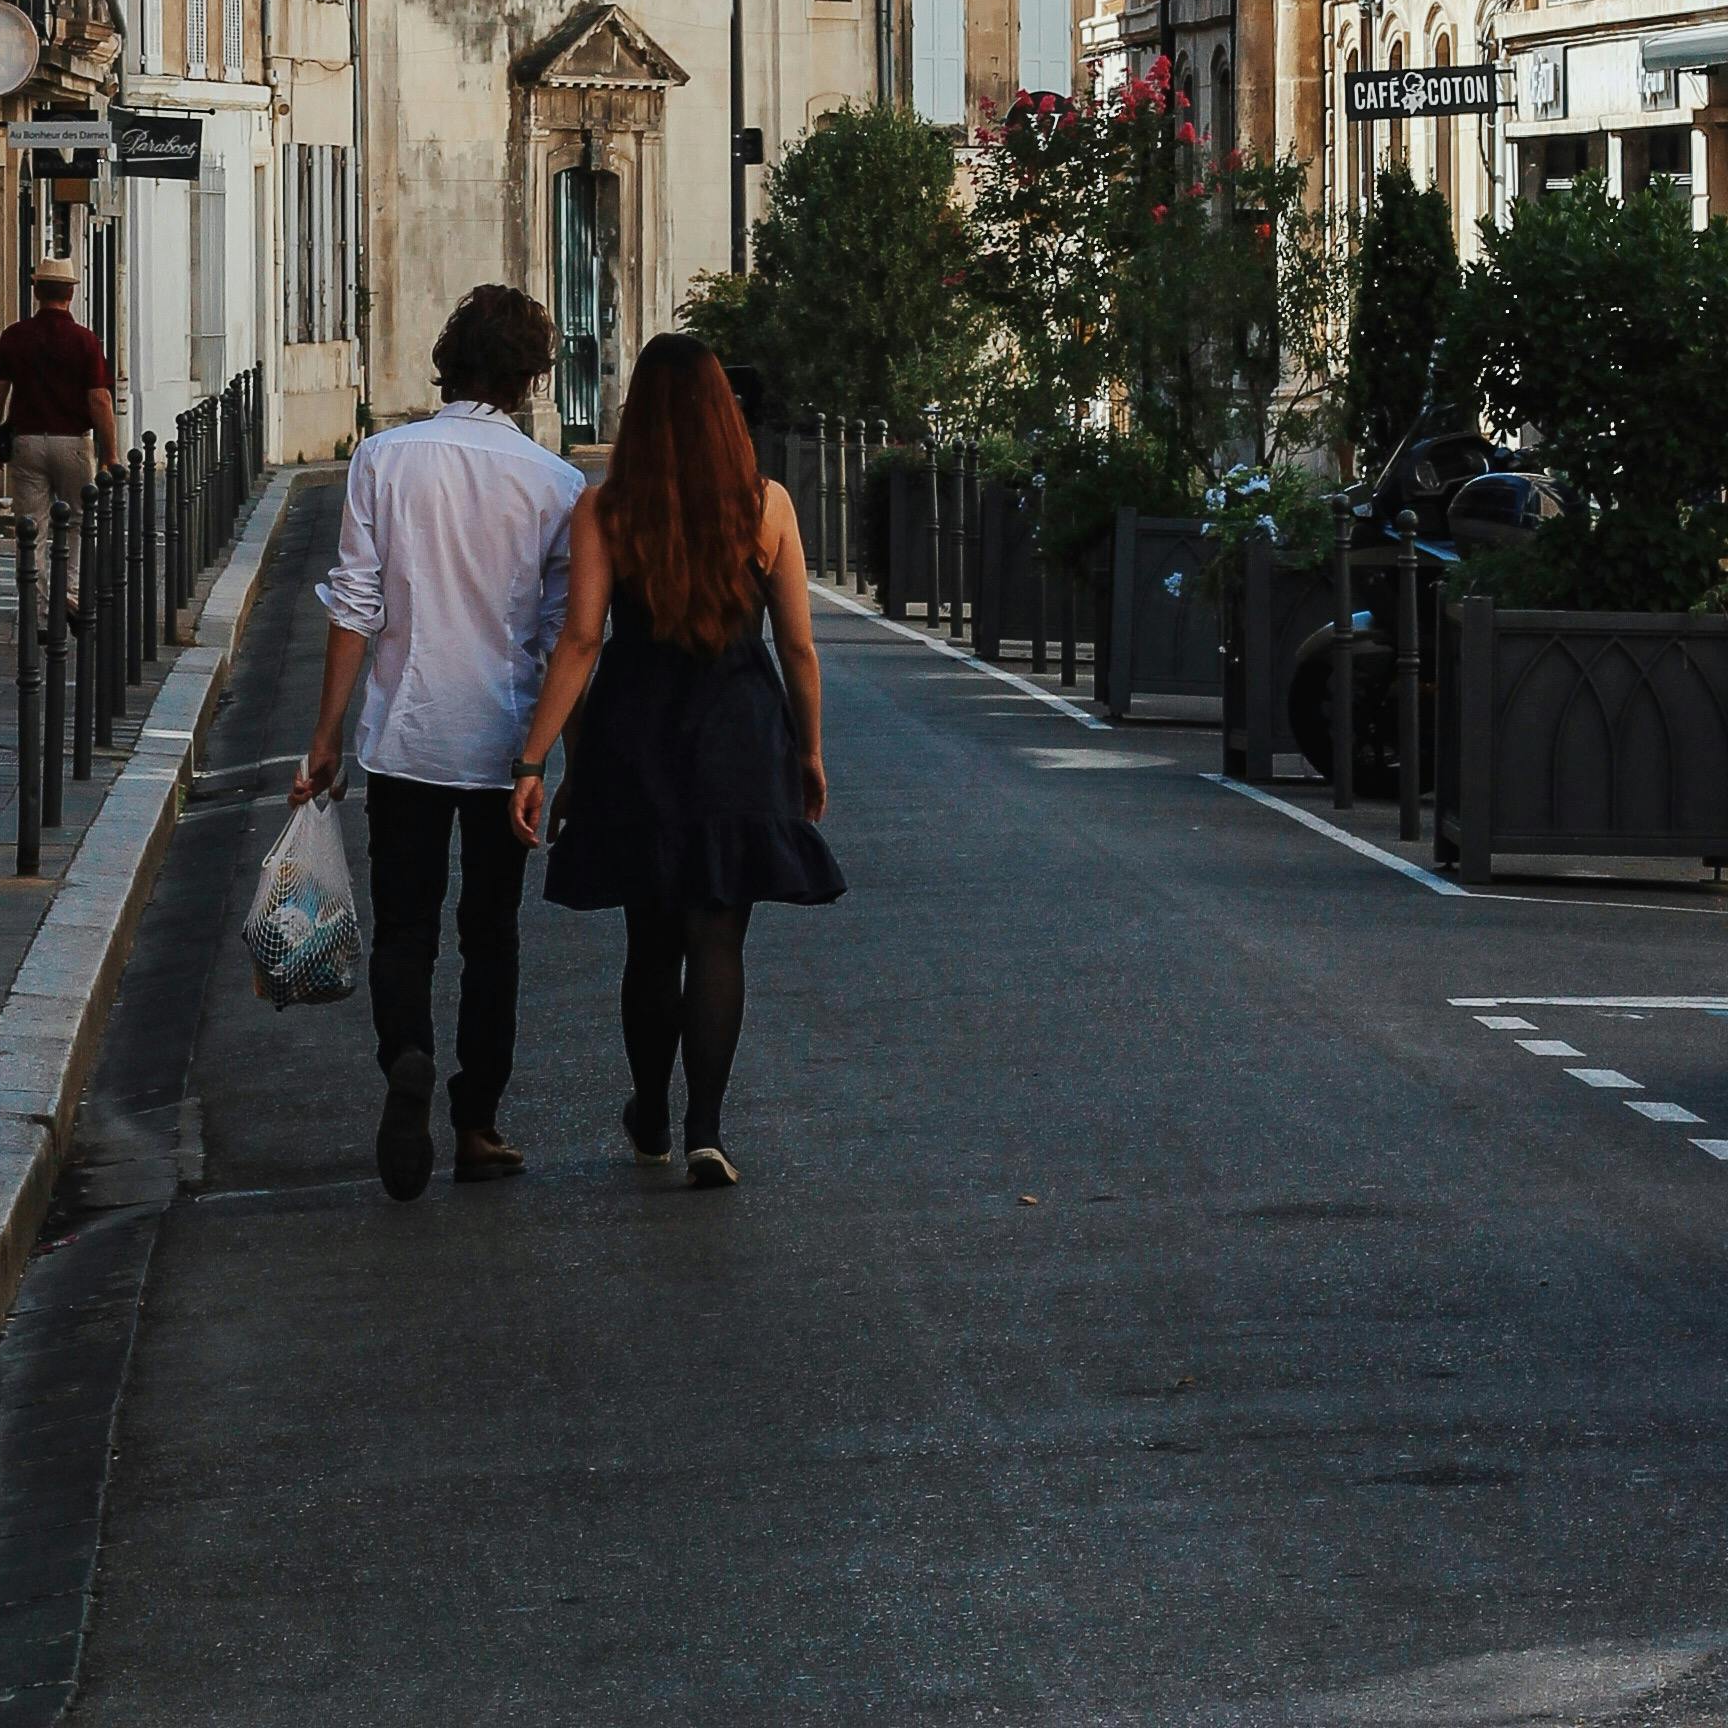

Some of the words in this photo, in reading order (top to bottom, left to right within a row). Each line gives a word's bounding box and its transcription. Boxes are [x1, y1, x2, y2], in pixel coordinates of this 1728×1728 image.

[1353, 77, 1401, 110] CAFÉ
[1427, 75, 1489, 105] COTON
[9, 130, 22, 140] Au
[23, 129, 60, 140] Bonheur
[62, 129, 78, 140] des
[79, 130, 110, 140] Dames
[122, 128, 198, 158] Paraboot
